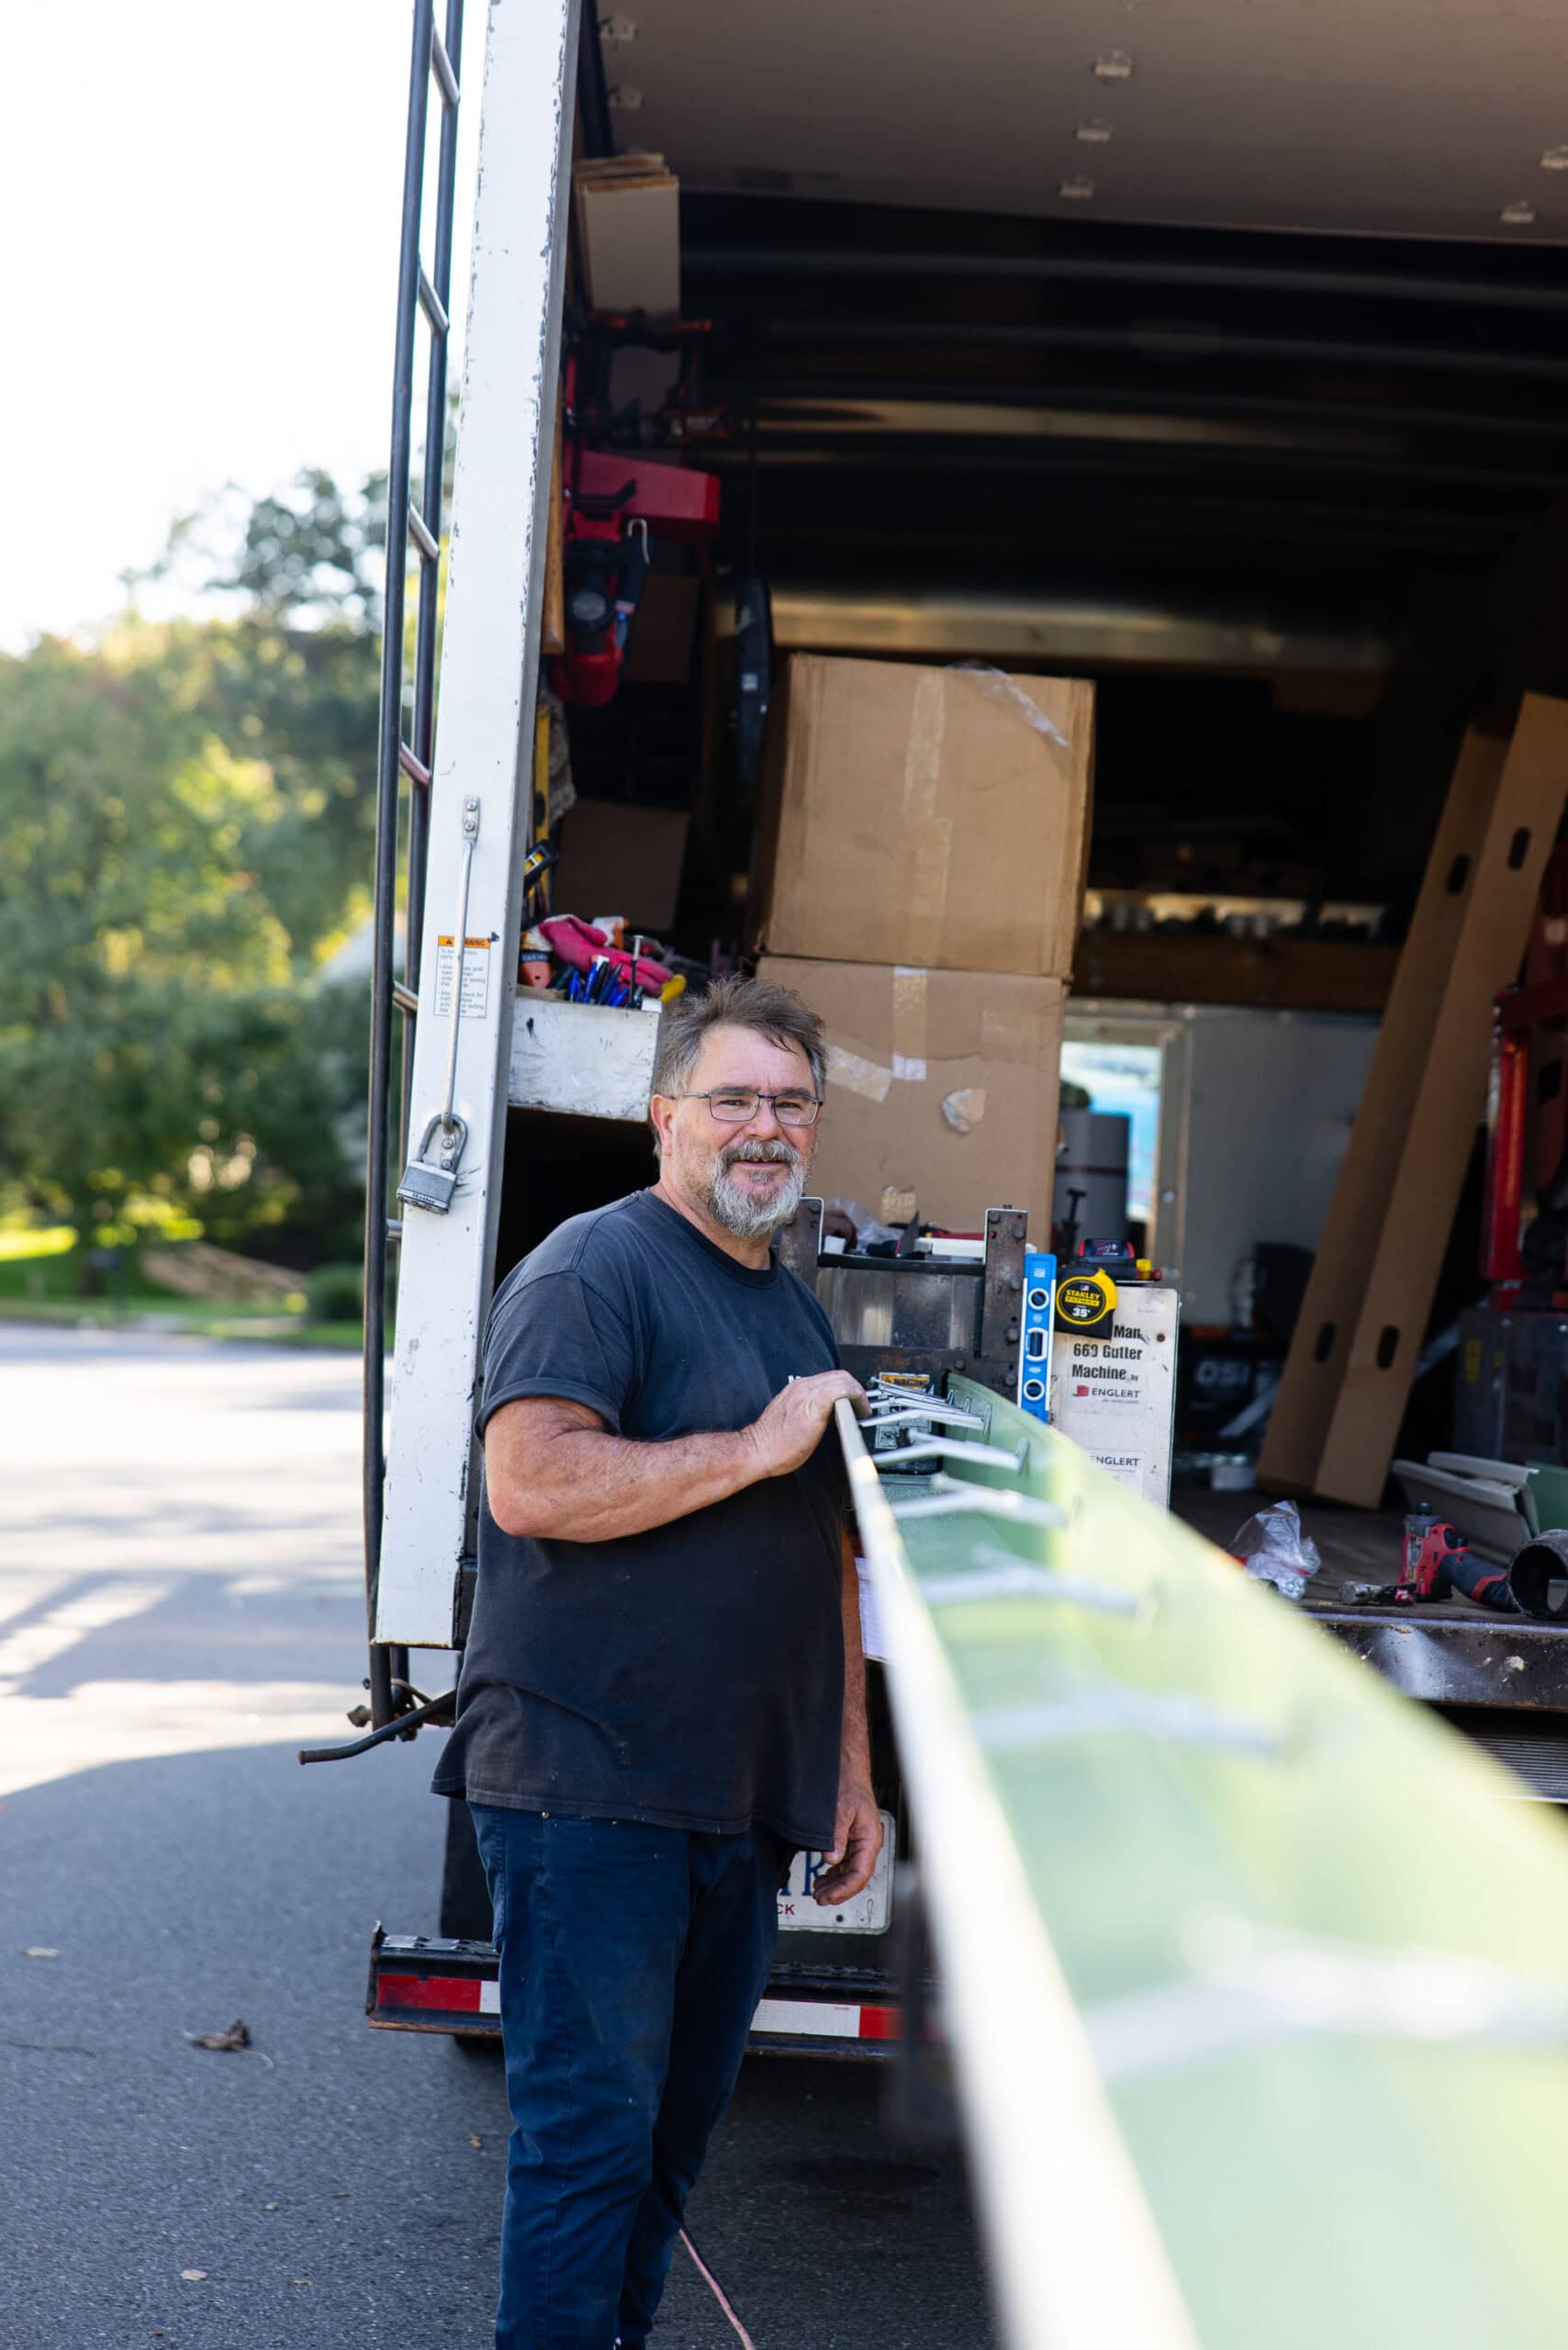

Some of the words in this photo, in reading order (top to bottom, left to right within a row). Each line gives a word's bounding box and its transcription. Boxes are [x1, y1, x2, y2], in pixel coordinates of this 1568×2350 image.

[1065, 1289, 1101, 1301] STANLEY
[1114, 1325, 1141, 1338] Man
[1103, 1345, 1143, 1360] Gutter
[1071, 1364, 1126, 1380] Machine
[1092, 1387, 1140, 1398] ENGLERT
